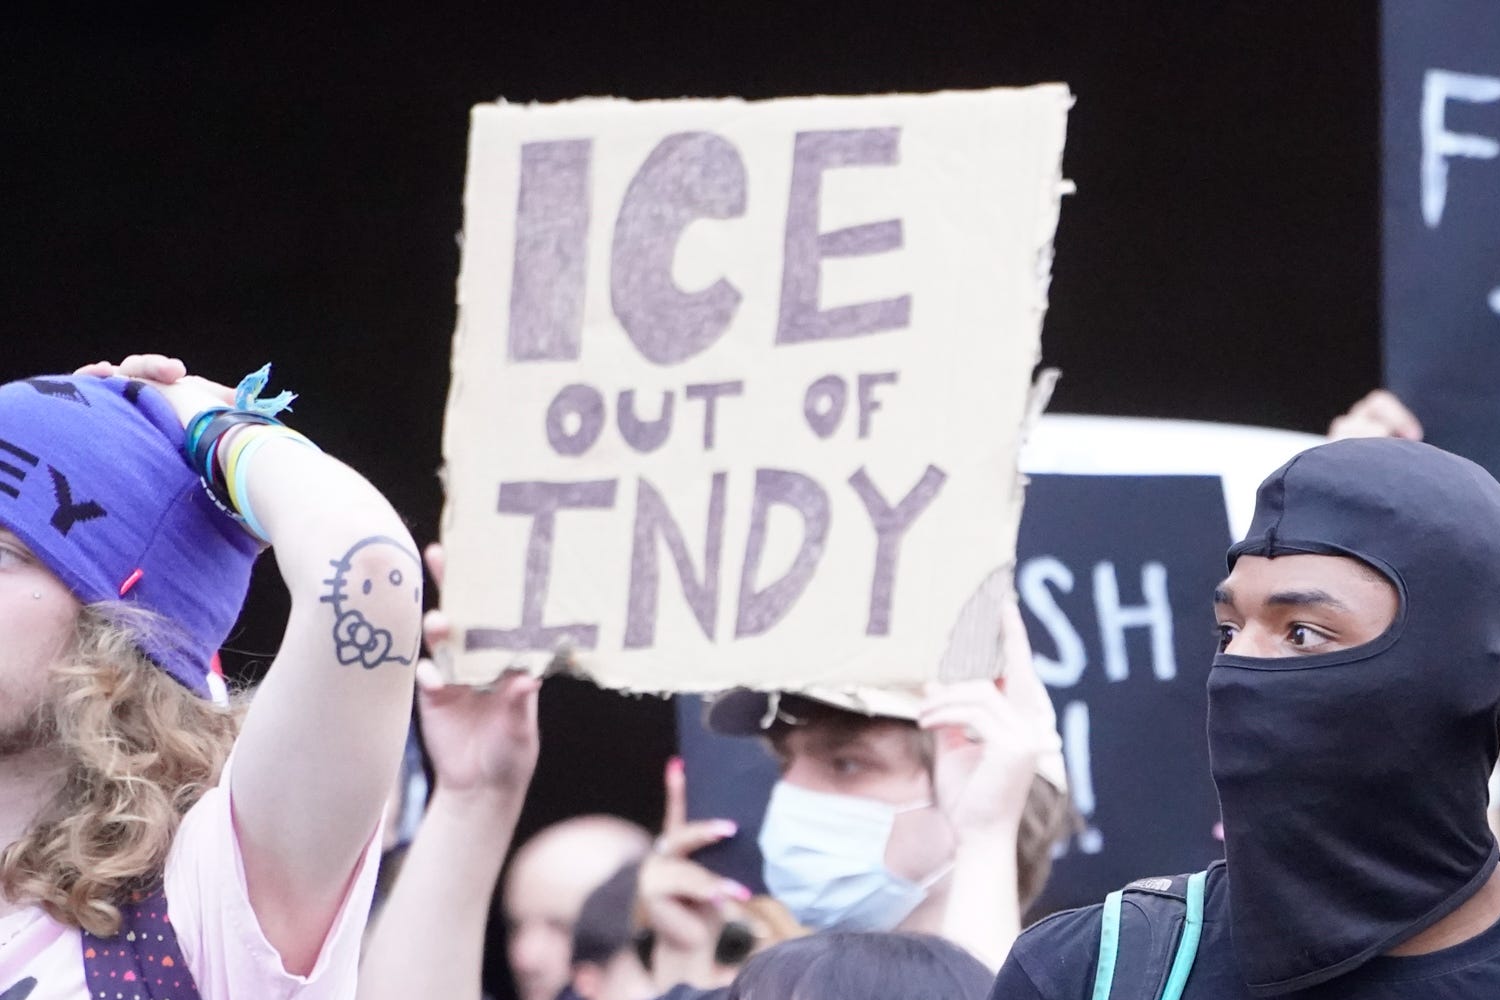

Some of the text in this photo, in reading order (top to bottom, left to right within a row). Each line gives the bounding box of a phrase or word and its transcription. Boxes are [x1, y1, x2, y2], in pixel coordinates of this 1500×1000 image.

[506, 125, 913, 366] ICE
[545, 371, 899, 457] OUT OF
[464, 464, 948, 651] INDY
